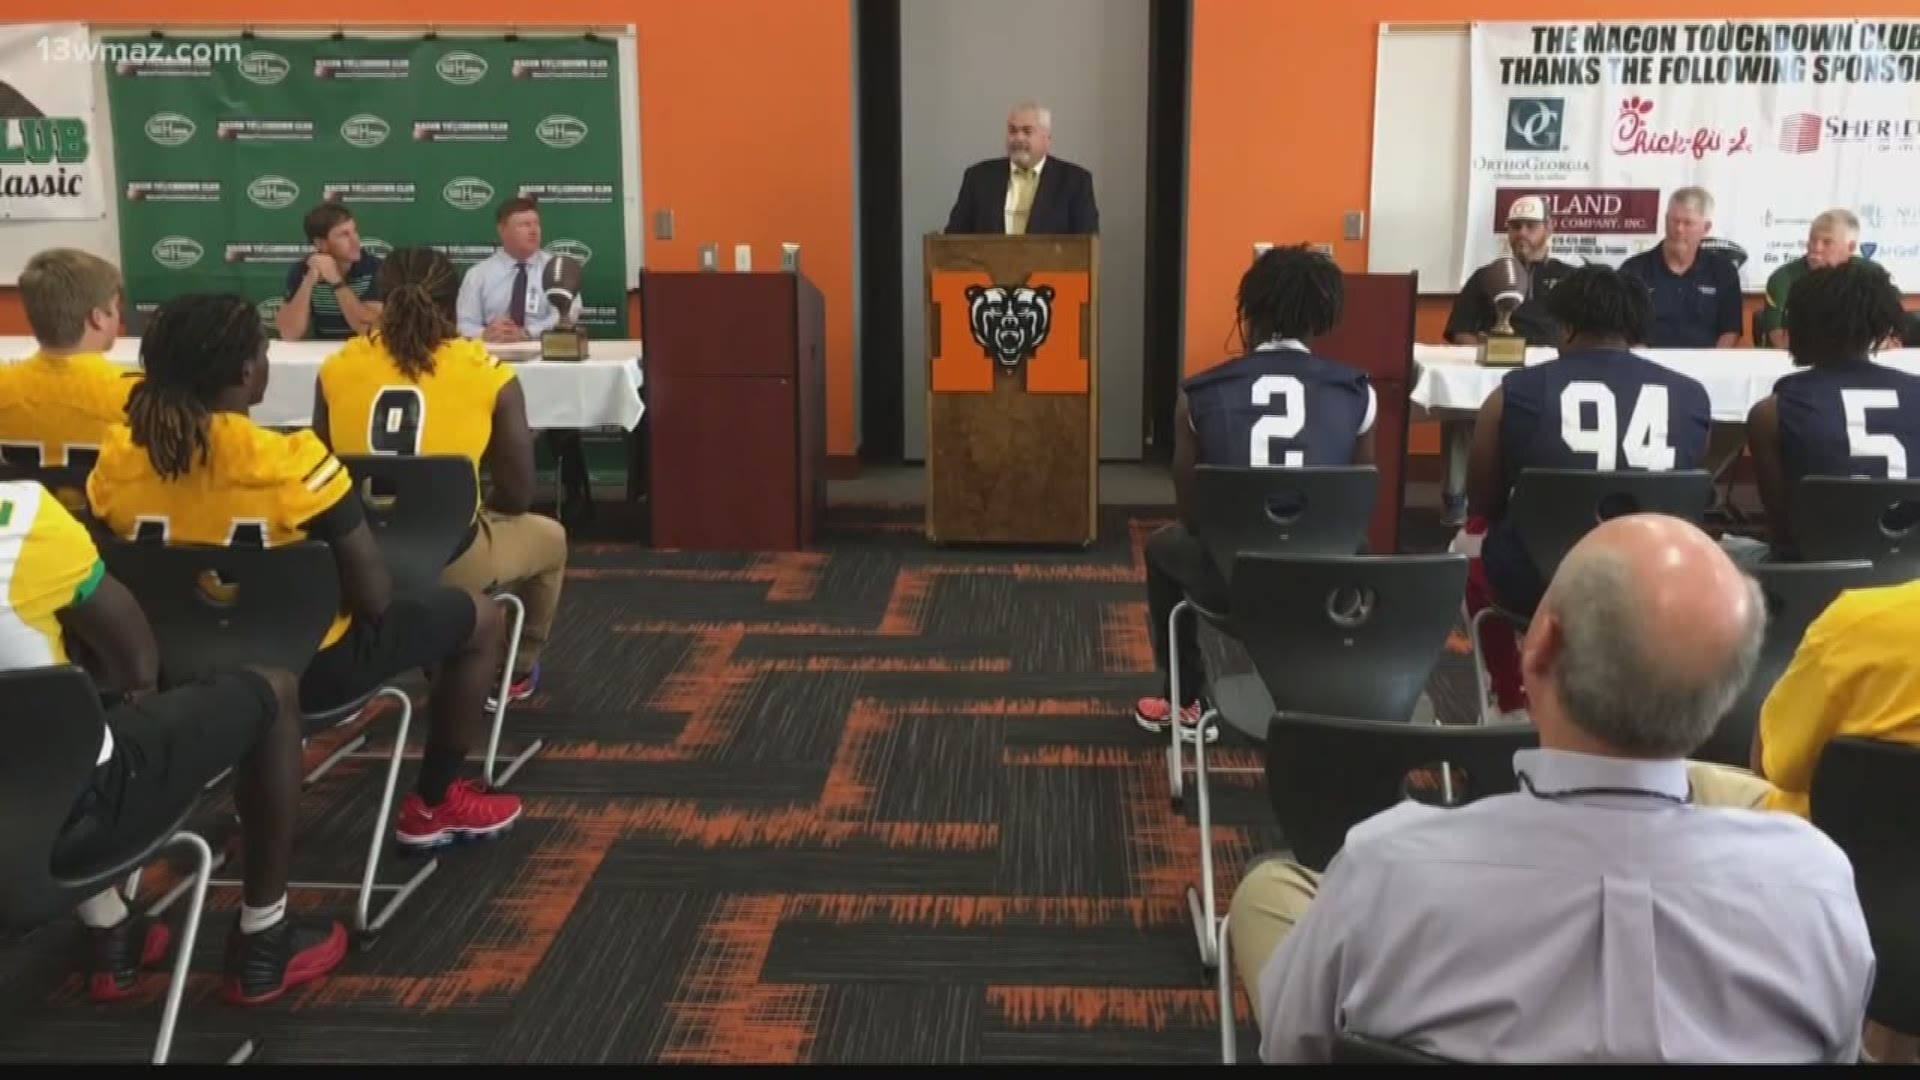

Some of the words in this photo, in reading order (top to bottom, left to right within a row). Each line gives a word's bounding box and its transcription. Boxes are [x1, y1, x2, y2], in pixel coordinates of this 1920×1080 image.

[1500, 58, 1600, 84] THANKS
[1608, 57, 1653, 84] THE
[1659, 56, 1807, 84] FOLLOWING
[1532, 26, 1578, 53] THE
[1583, 25, 1677, 53] MACON
[1684, 24, 1852, 52] TOUCHDOWN
[1859, 23, 1920, 51] CLUB
[0, 167, 83, 197] assic
[367, 384, 425, 456] 9
[1250, 374, 1306, 467] 2
[1560, 381, 1676, 472] 94
[1841, 389, 1907, 480] 5
